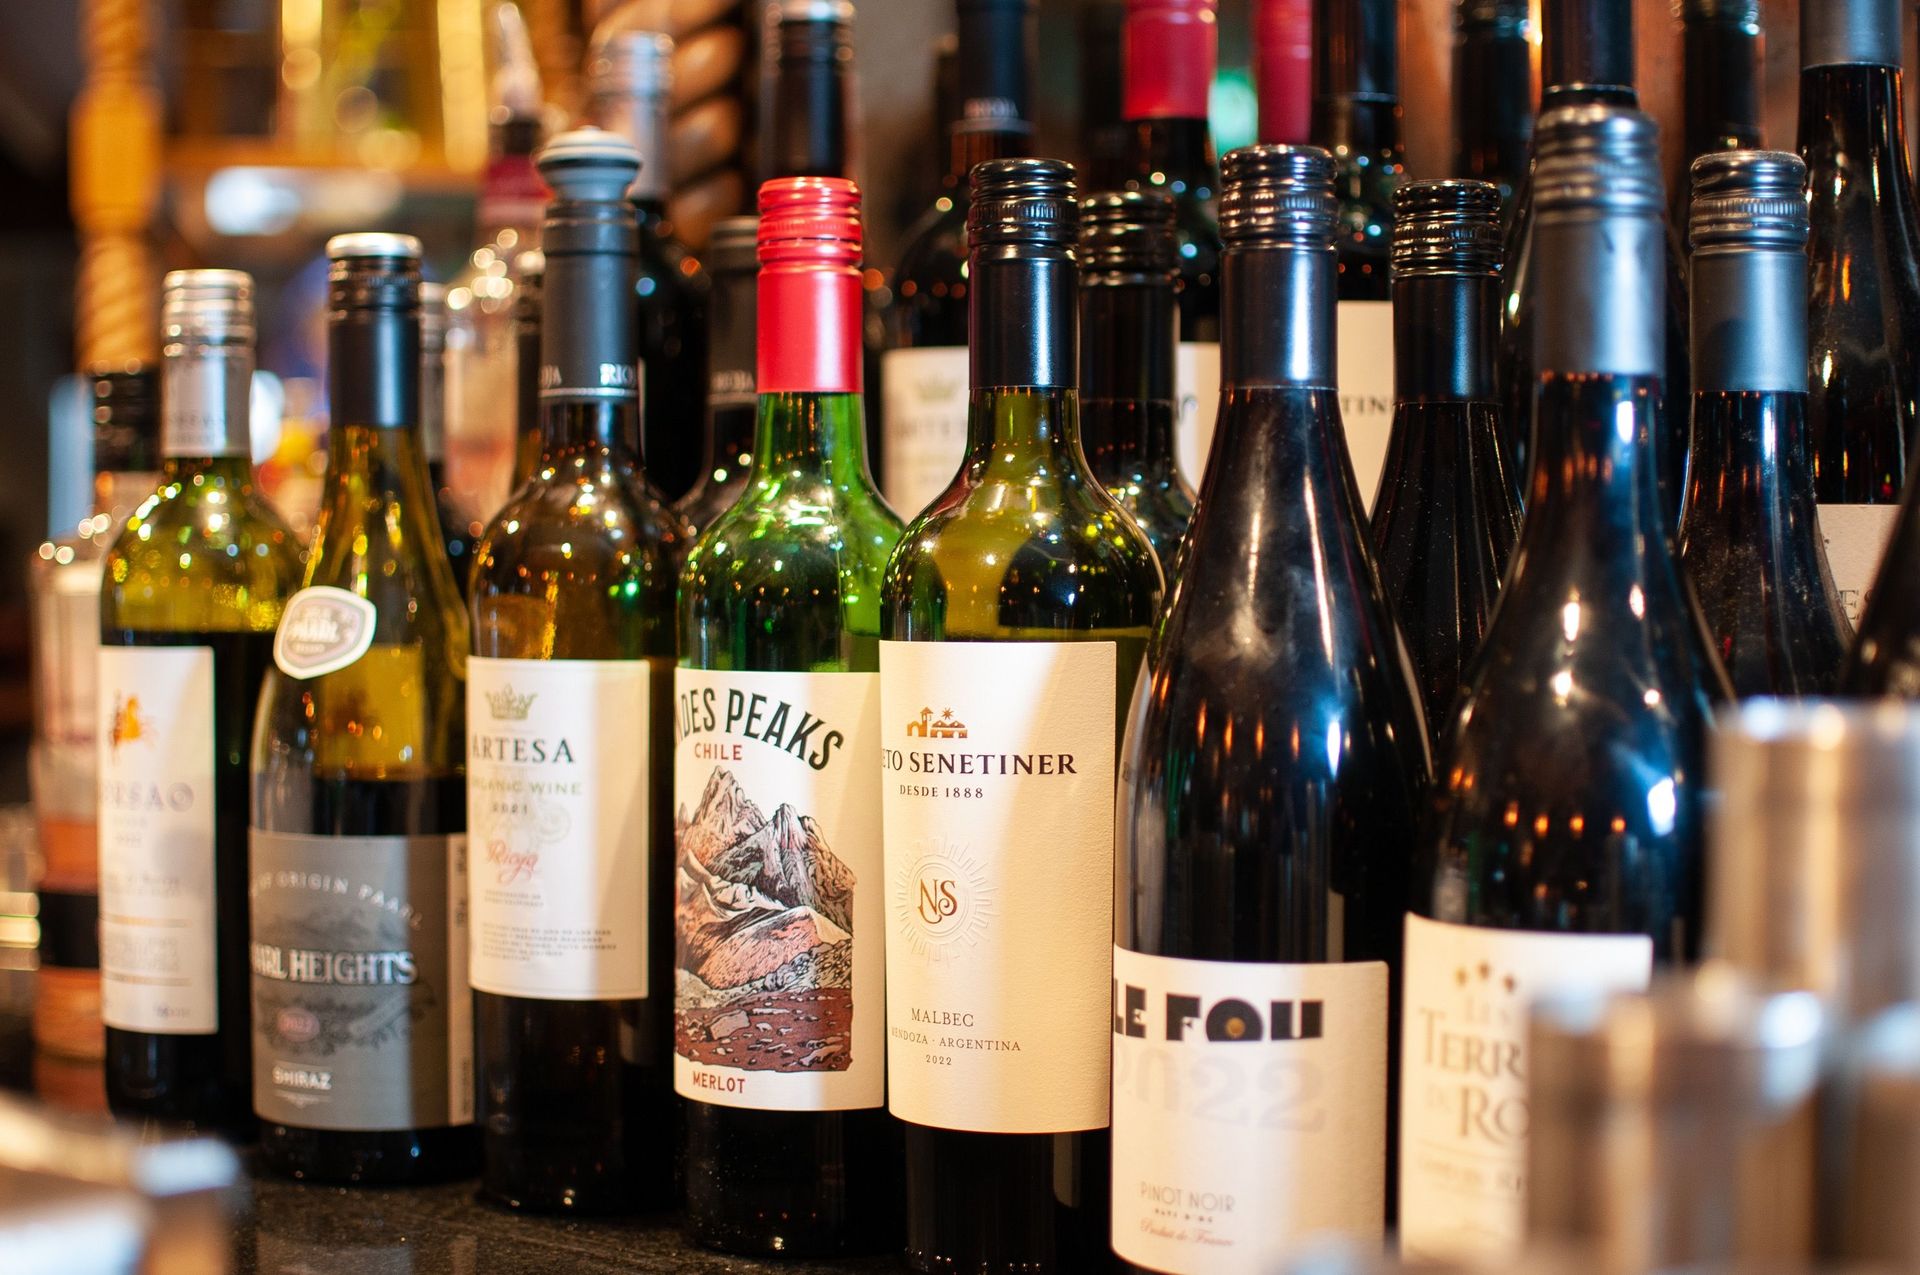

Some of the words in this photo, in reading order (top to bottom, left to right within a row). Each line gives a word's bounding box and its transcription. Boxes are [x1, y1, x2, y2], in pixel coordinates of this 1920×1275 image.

[725, 688, 844, 771] PEAKS
[472, 735, 575, 763] ARTESA
[694, 742, 743, 760] CHILE
[909, 751, 1078, 776] SENETINER
[529, 782, 582, 796] WINE
[900, 784, 939, 798] DESDE
[945, 787, 984, 799] 1888
[274, 870, 349, 895] ORIGIN
[917, 879, 958, 924] NS
[289, 949, 417, 985] HEIGHTS
[911, 1008, 975, 1028] MALBEC
[1114, 978, 1147, 1039] LE
[1166, 993, 1324, 1042] FOU
[891, 1027, 929, 1045] MENDOZA
[939, 1037, 1022, 1052] ARGENTINA
[925, 1054, 953, 1066] 2022
[271, 1063, 332, 1091] SHIRAZ
[693, 1070, 746, 1094] MERLOT
[1140, 1181, 1182, 1206] PINOT
[1189, 1192, 1235, 1213] NOIR
